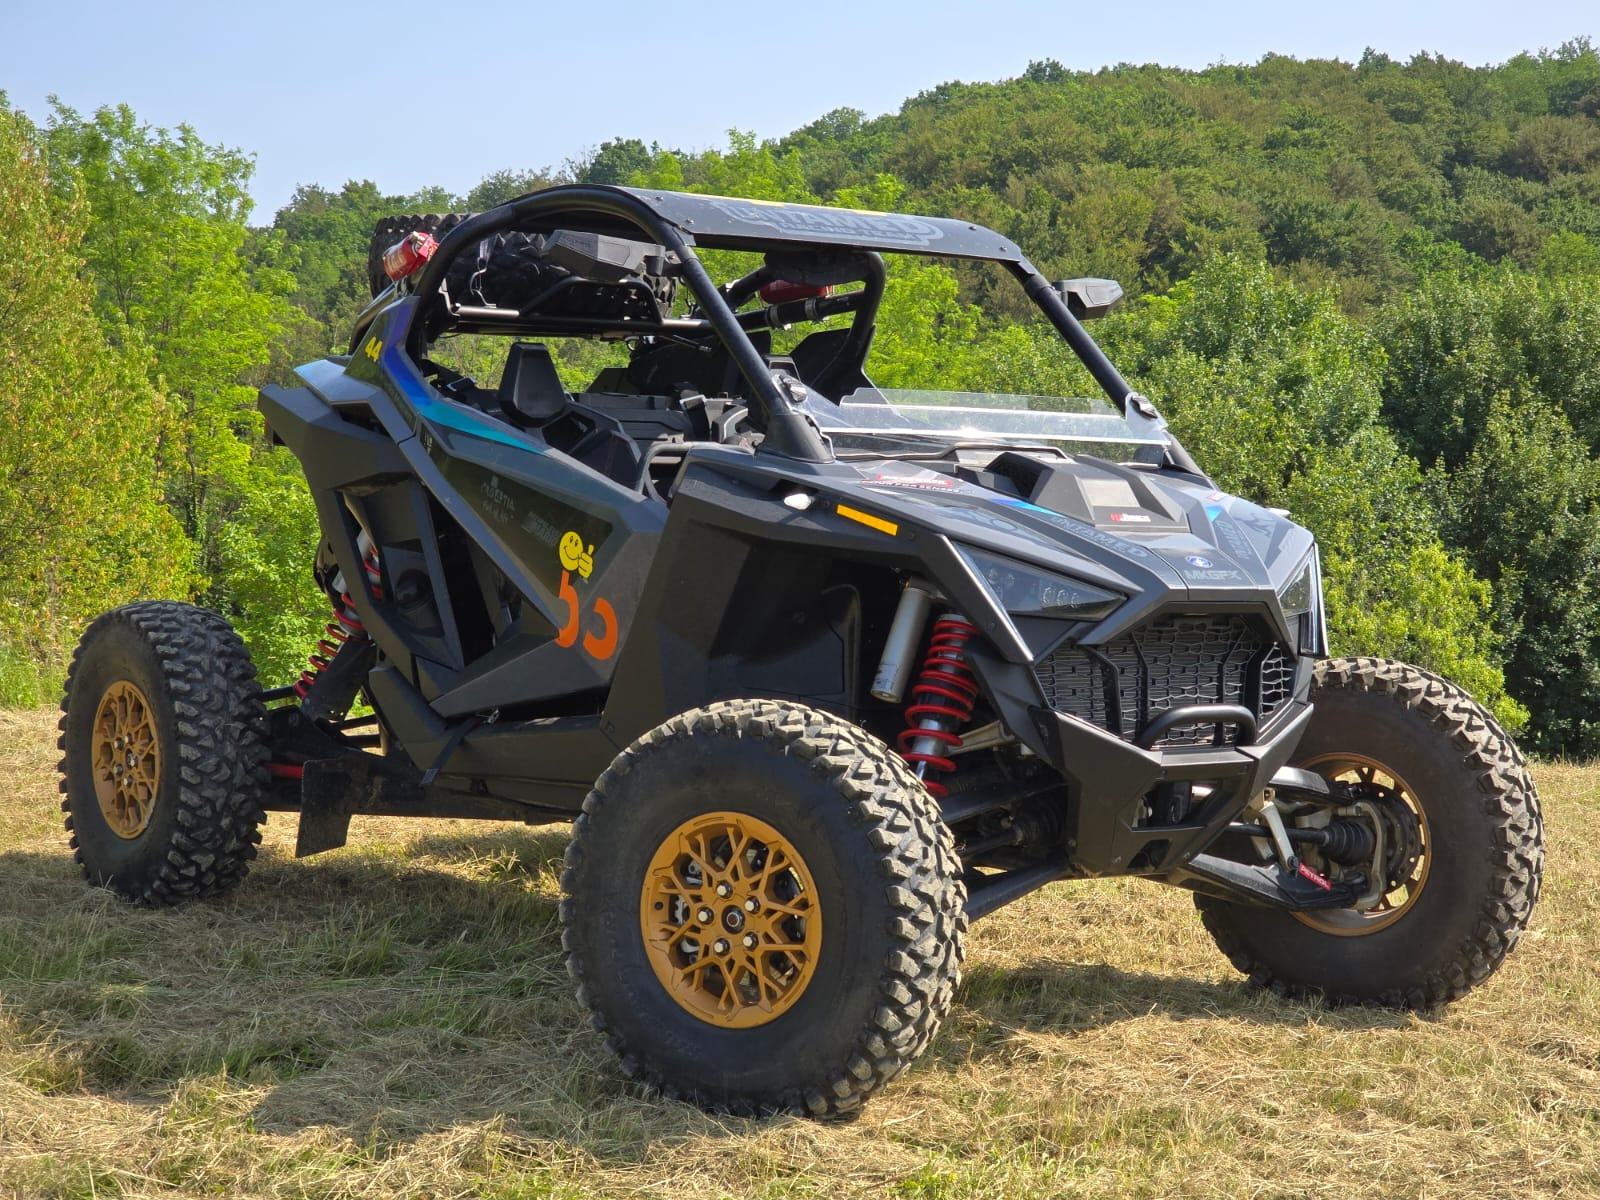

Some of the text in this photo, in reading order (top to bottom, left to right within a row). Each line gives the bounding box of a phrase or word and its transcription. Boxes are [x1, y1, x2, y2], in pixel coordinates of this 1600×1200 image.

[721, 201, 932, 235] UNTAMED
[365, 336, 383, 363] 44
[1052, 515, 1148, 557] UNTAMED
